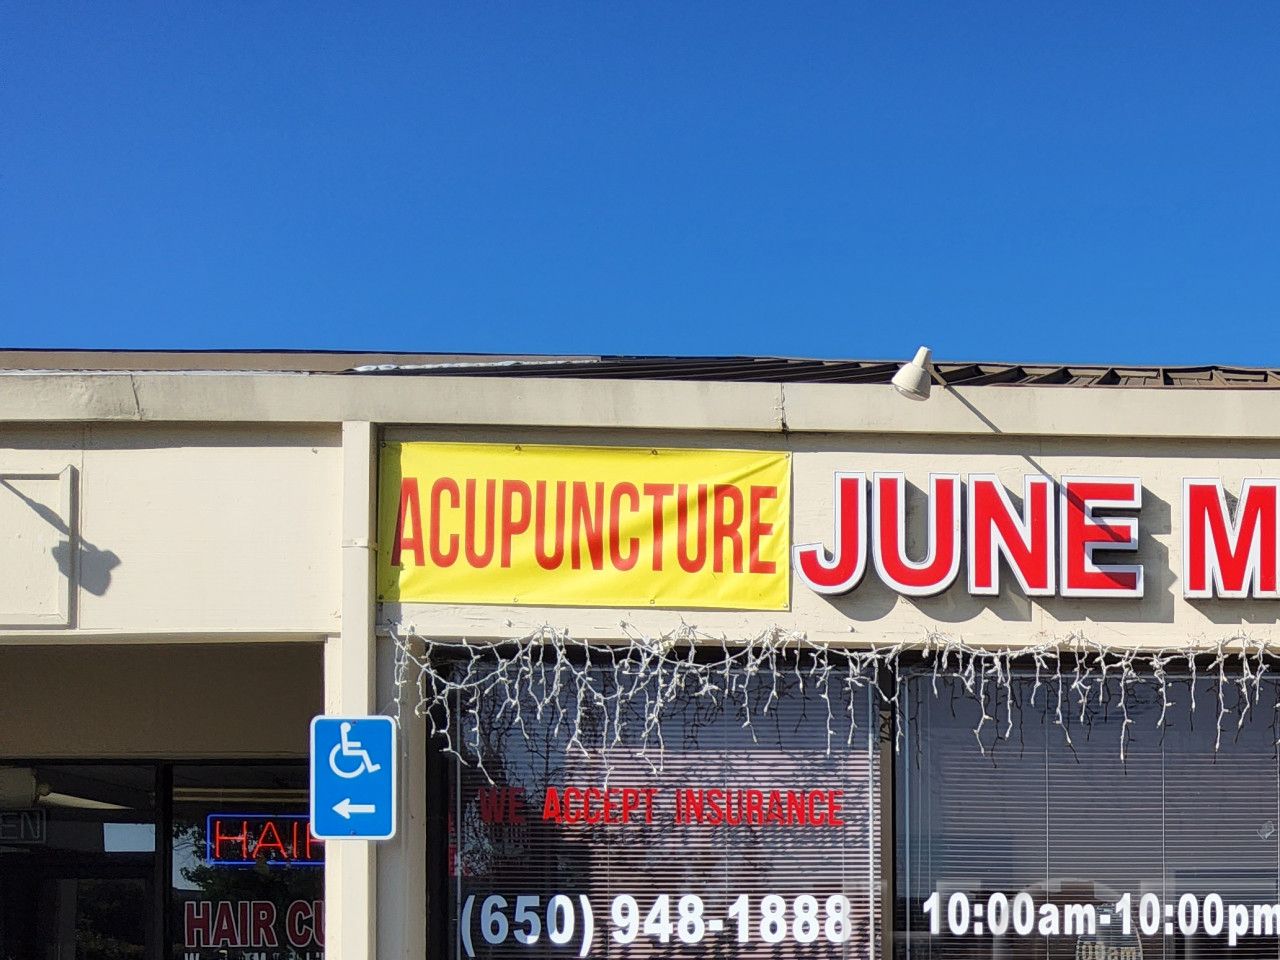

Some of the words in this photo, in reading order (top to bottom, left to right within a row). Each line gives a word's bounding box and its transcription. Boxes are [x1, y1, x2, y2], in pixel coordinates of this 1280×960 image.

[391, 476, 778, 574] ACUPUNCTURE
[793, 471, 1144, 599] JUNE
[479, 786, 526, 824] WE
[542, 786, 660, 825] ACCEPT
[675, 788, 845, 826] INSURANCE
[185, 901, 278, 948] HAIR
[461, 894, 595, 958] (650)
[611, 894, 852, 945] 948-1888
